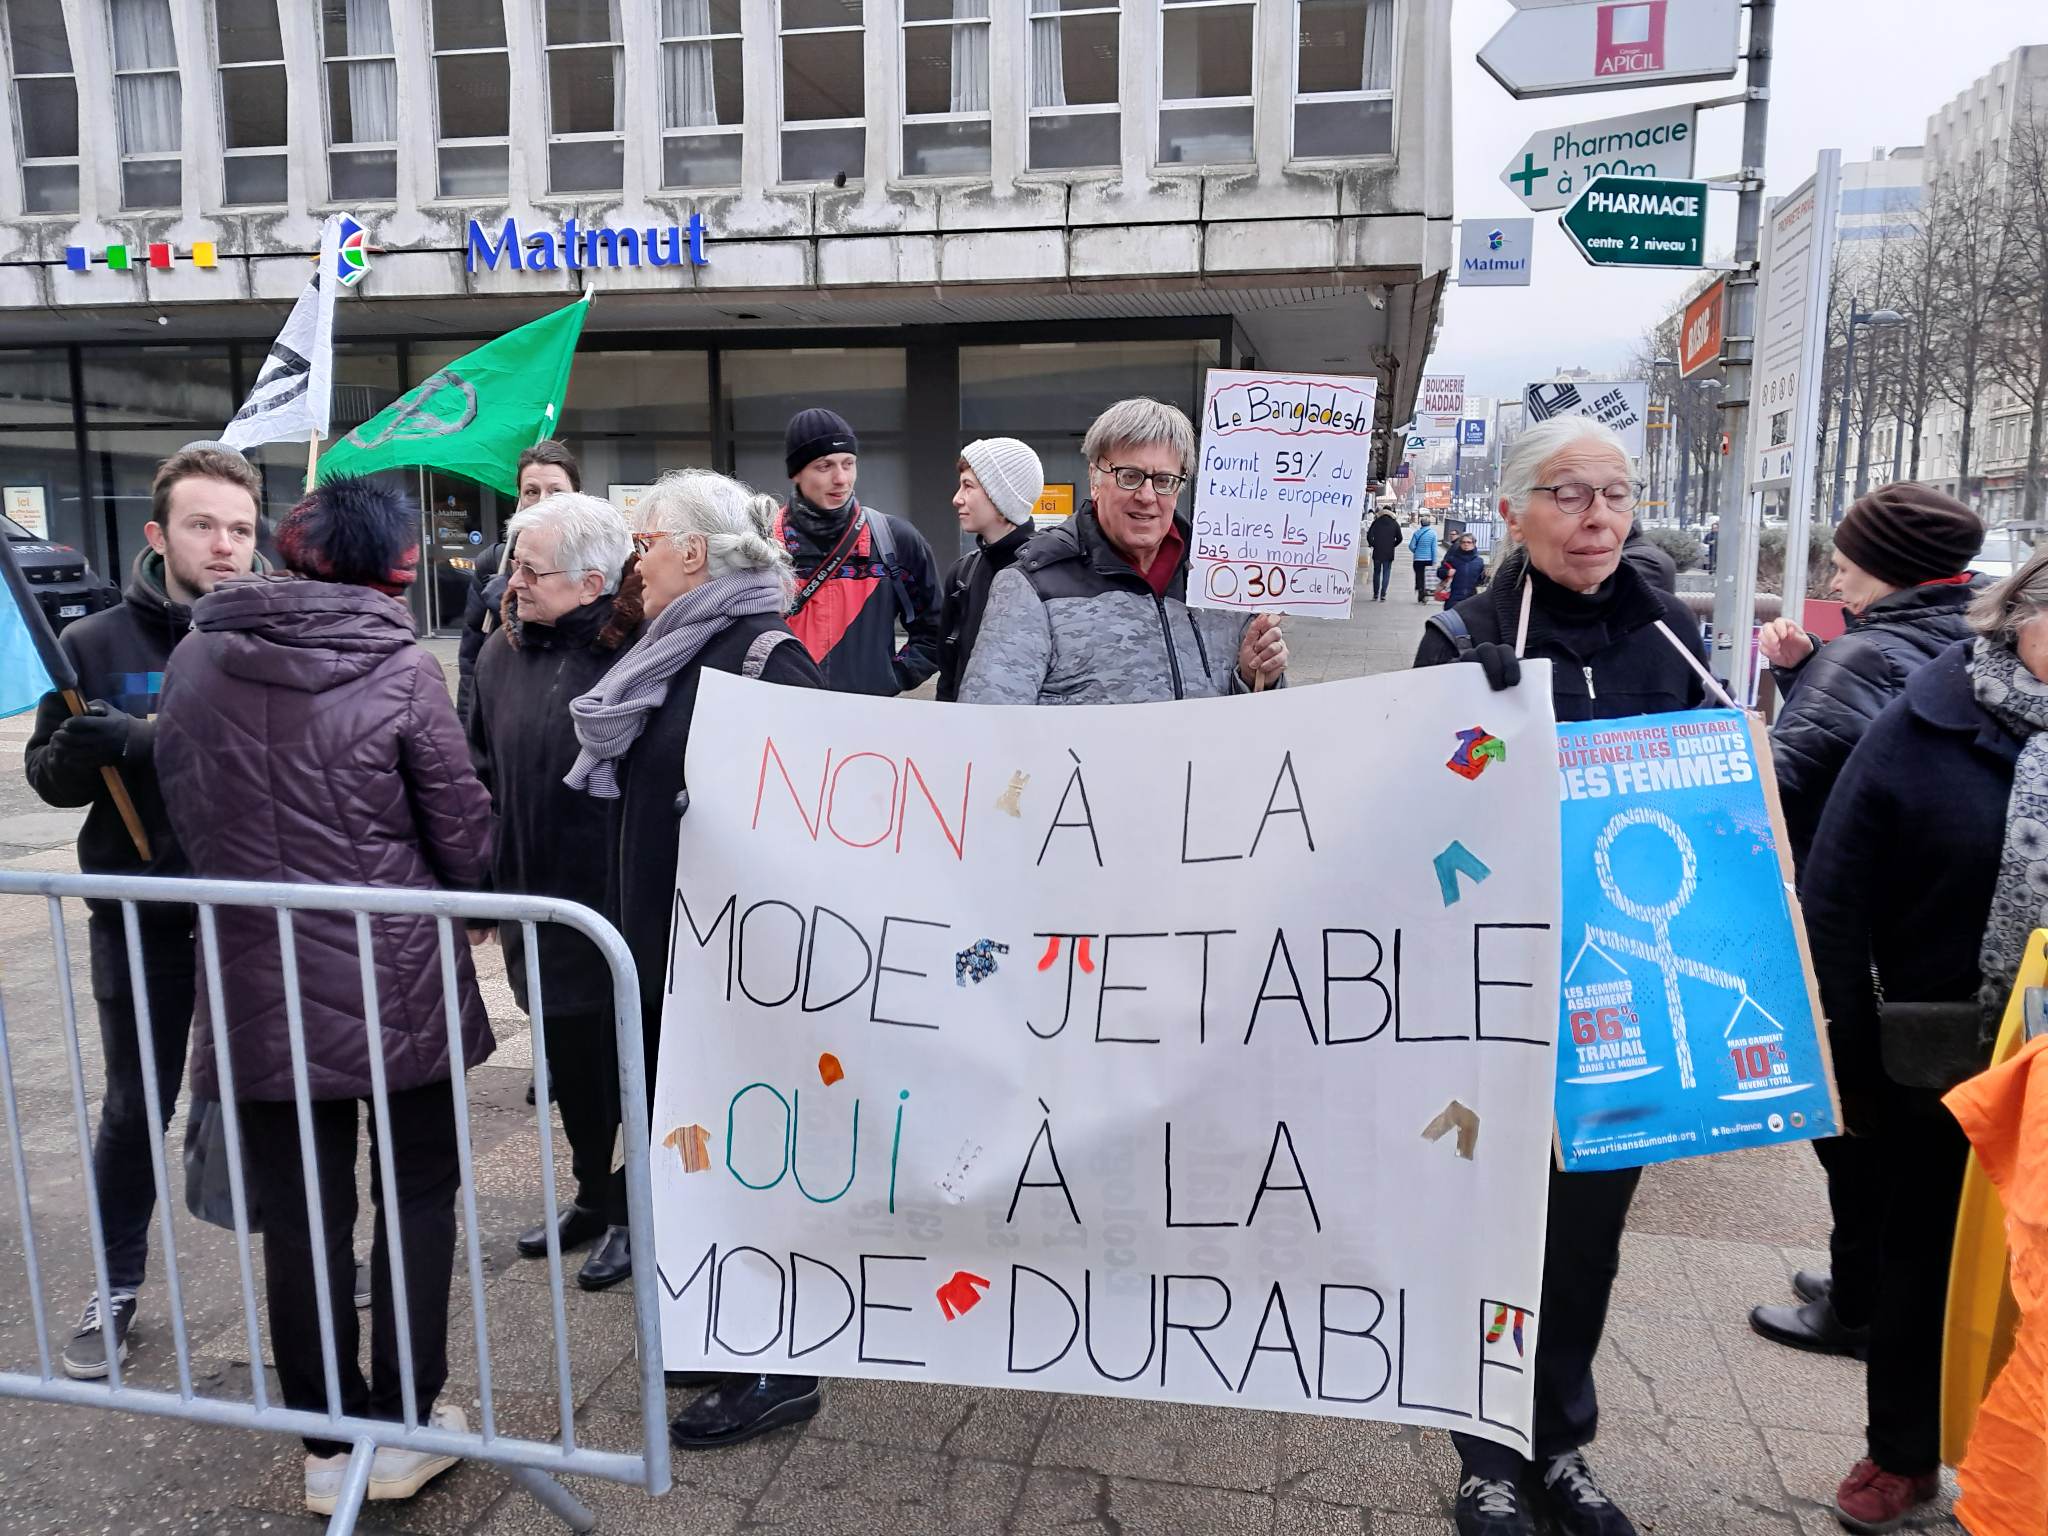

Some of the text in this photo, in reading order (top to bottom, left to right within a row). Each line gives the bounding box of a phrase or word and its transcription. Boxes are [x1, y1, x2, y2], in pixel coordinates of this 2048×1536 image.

[1600, 53, 1660, 73] APICIL
[1553, 122, 1689, 161] Pharmacie
[1557, 171, 1572, 194] à
[1587, 191, 1699, 217] PHARMACIE
[466, 212, 711, 273] Matmut
[1587, 236, 1697, 251] centre 2 niveau 1
[1463, 256, 1526, 271] Matmut
[1426, 379, 1464, 393] BOUCHERIE
[1213, 383, 1366, 432] Le Bangladesh
[1425, 394, 1463, 412] HADDADI
[1580, 388, 1624, 418] ALERIE
[1596, 400, 1630, 424] ANDE
[1275, 450, 1323, 478] 59%
[1331, 459, 1352, 480] du
[1210, 477, 1268, 501] textile
[1040, 499, 1056, 511] ici
[1197, 510, 1351, 553] Salaires les plus
[1198, 538, 1329, 565] bas du monde
[802, 579, 820, 597] EOS
[1309, 577, 1322, 593] de
[1558, 732, 1746, 768] UTENEZ LES DROITS
[1574, 735, 1589, 748] LE
[1592, 727, 1668, 746] COMMERCE
[1613, 750, 1753, 795] FEMMES
[752, 736, 1315, 867] NON À LA
[668, 888, 1551, 1046] MODE JETABLE
[1564, 980, 1633, 999] LES FEMMES
[1567, 991, 1632, 1010] ASSUMENT
[1570, 1003, 1641, 1046] 66% DU
[1575, 1039, 1646, 1063] TRAVAIL
[1730, 1043, 1789, 1081] 10% DU
[1579, 1056, 1648, 1074] DANS LE MONDE
[1769, 1075, 1793, 1086] TOTAL
[1573, 1131, 1697, 1160] www.artisansdumonde.org
[1006, 1096, 1082, 1224] À
[1164, 1120, 1322, 1233] LA
[656, 1243, 1535, 1445] MODE DURABLE
